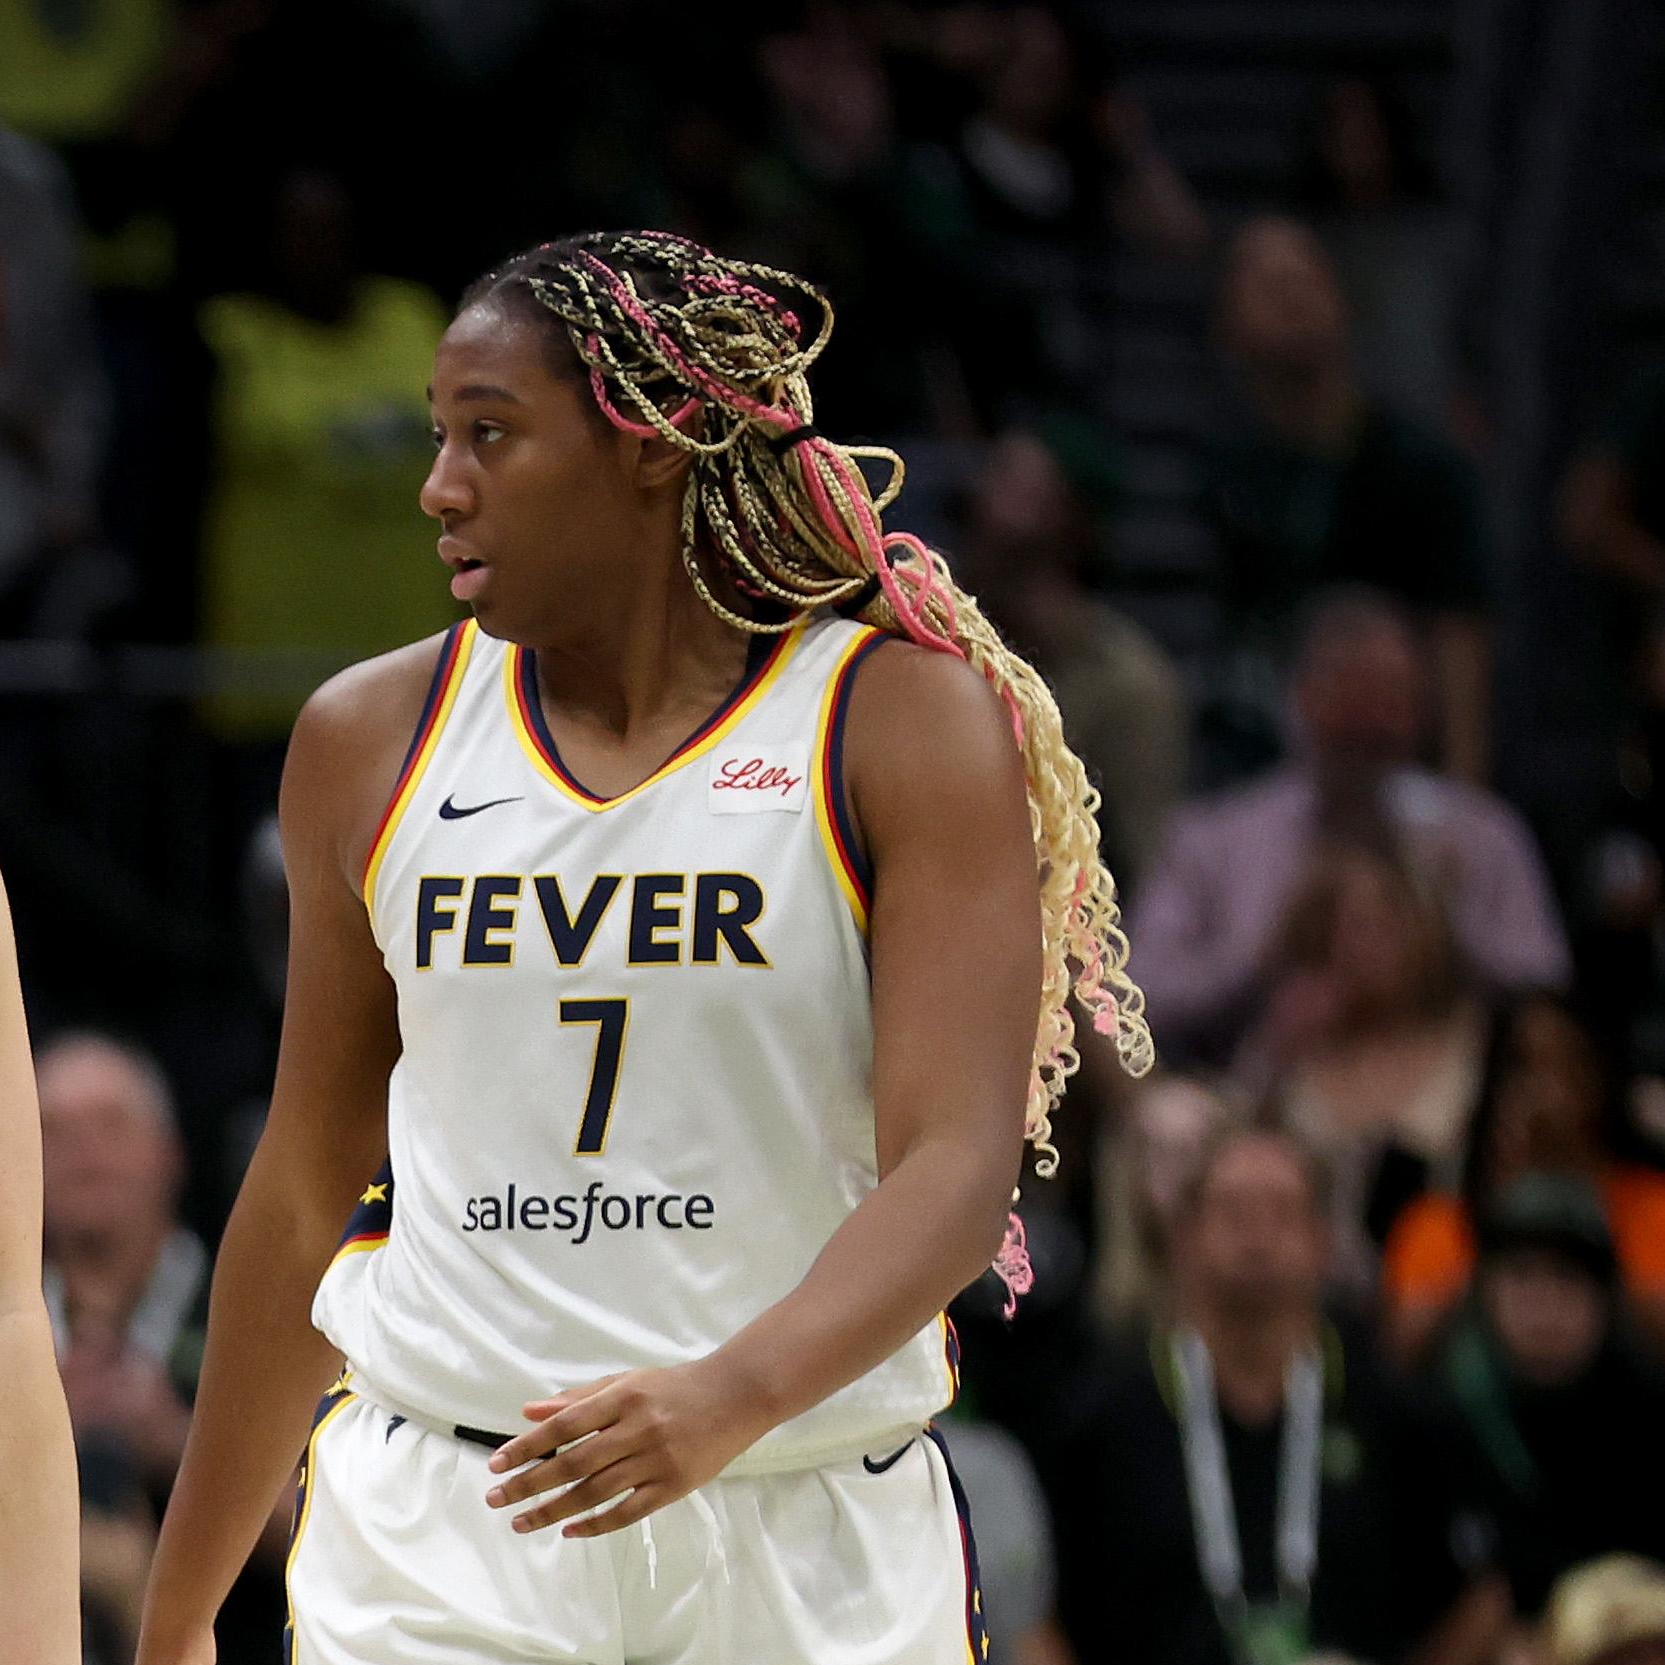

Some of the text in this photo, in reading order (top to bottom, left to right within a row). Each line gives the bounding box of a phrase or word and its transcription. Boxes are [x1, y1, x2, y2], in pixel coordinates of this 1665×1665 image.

[712, 757, 802, 797] Lilly
[415, 871, 774, 971] FEVER
[556, 996, 630, 1157] 7
[462, 1182, 715, 1244] salesforce
